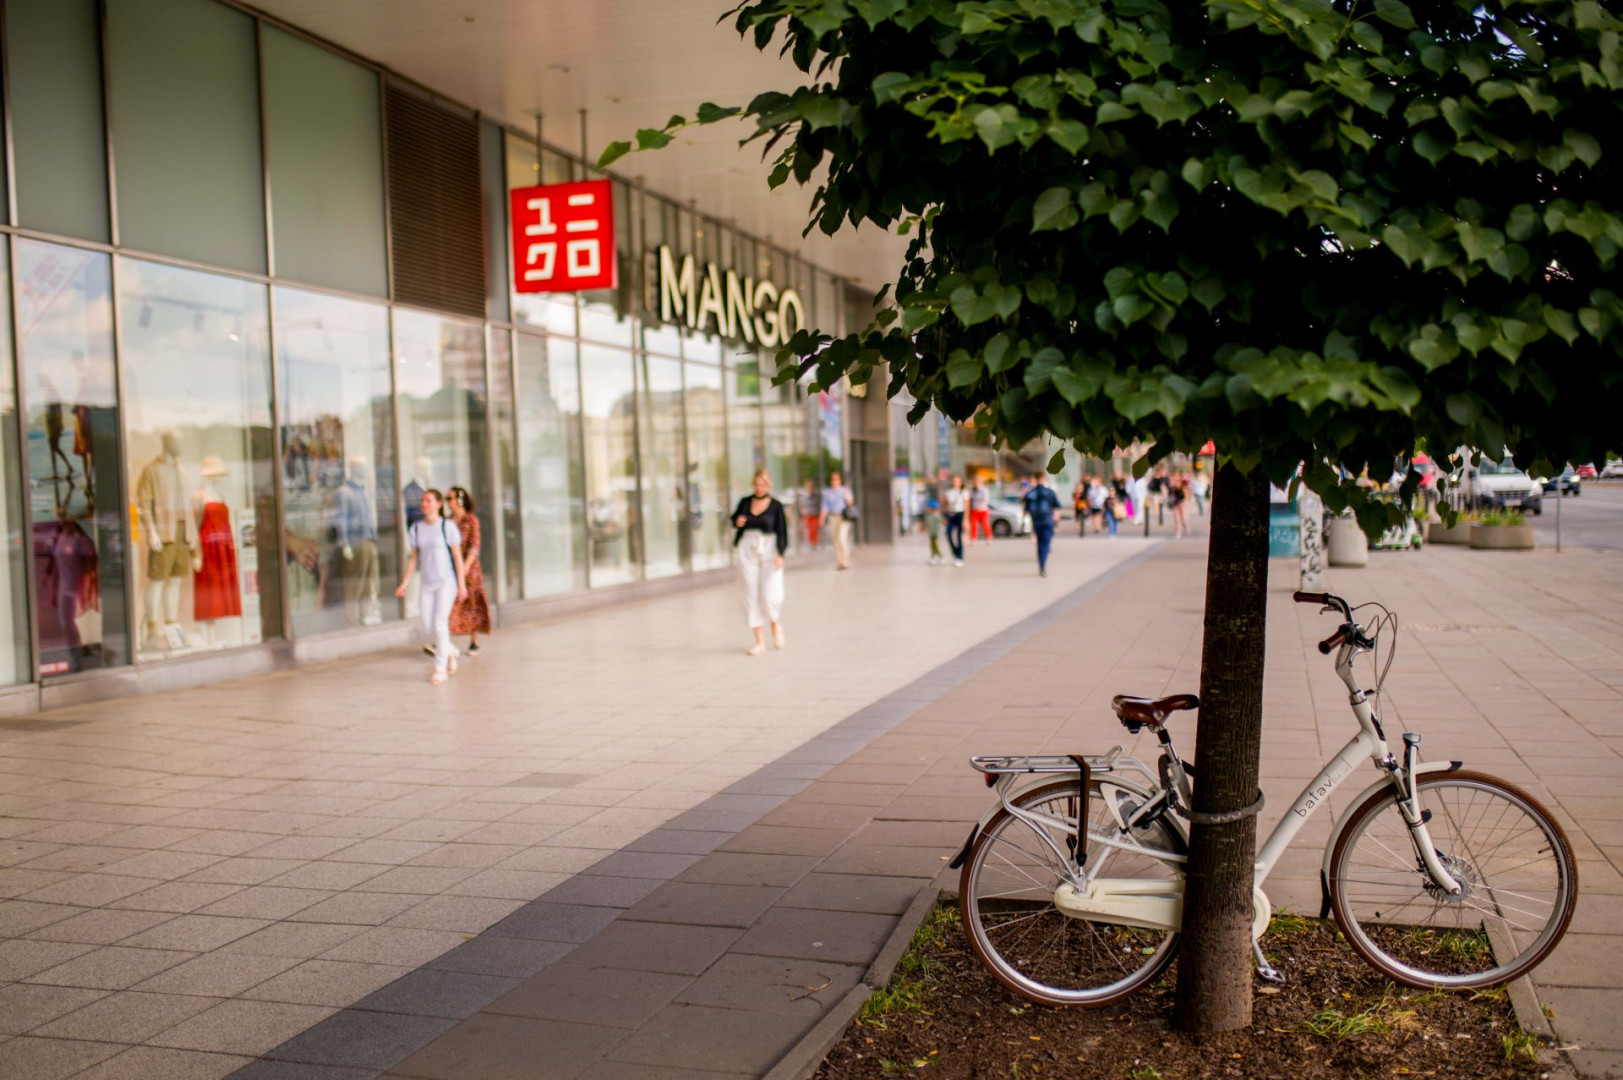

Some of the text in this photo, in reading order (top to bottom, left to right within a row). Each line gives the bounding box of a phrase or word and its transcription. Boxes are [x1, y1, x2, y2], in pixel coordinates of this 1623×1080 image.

[525, 193, 599, 236] ユニ
[524, 238, 600, 281] クロ
[659, 244, 805, 348] MANGO
[1294, 769, 1347, 818] batav
